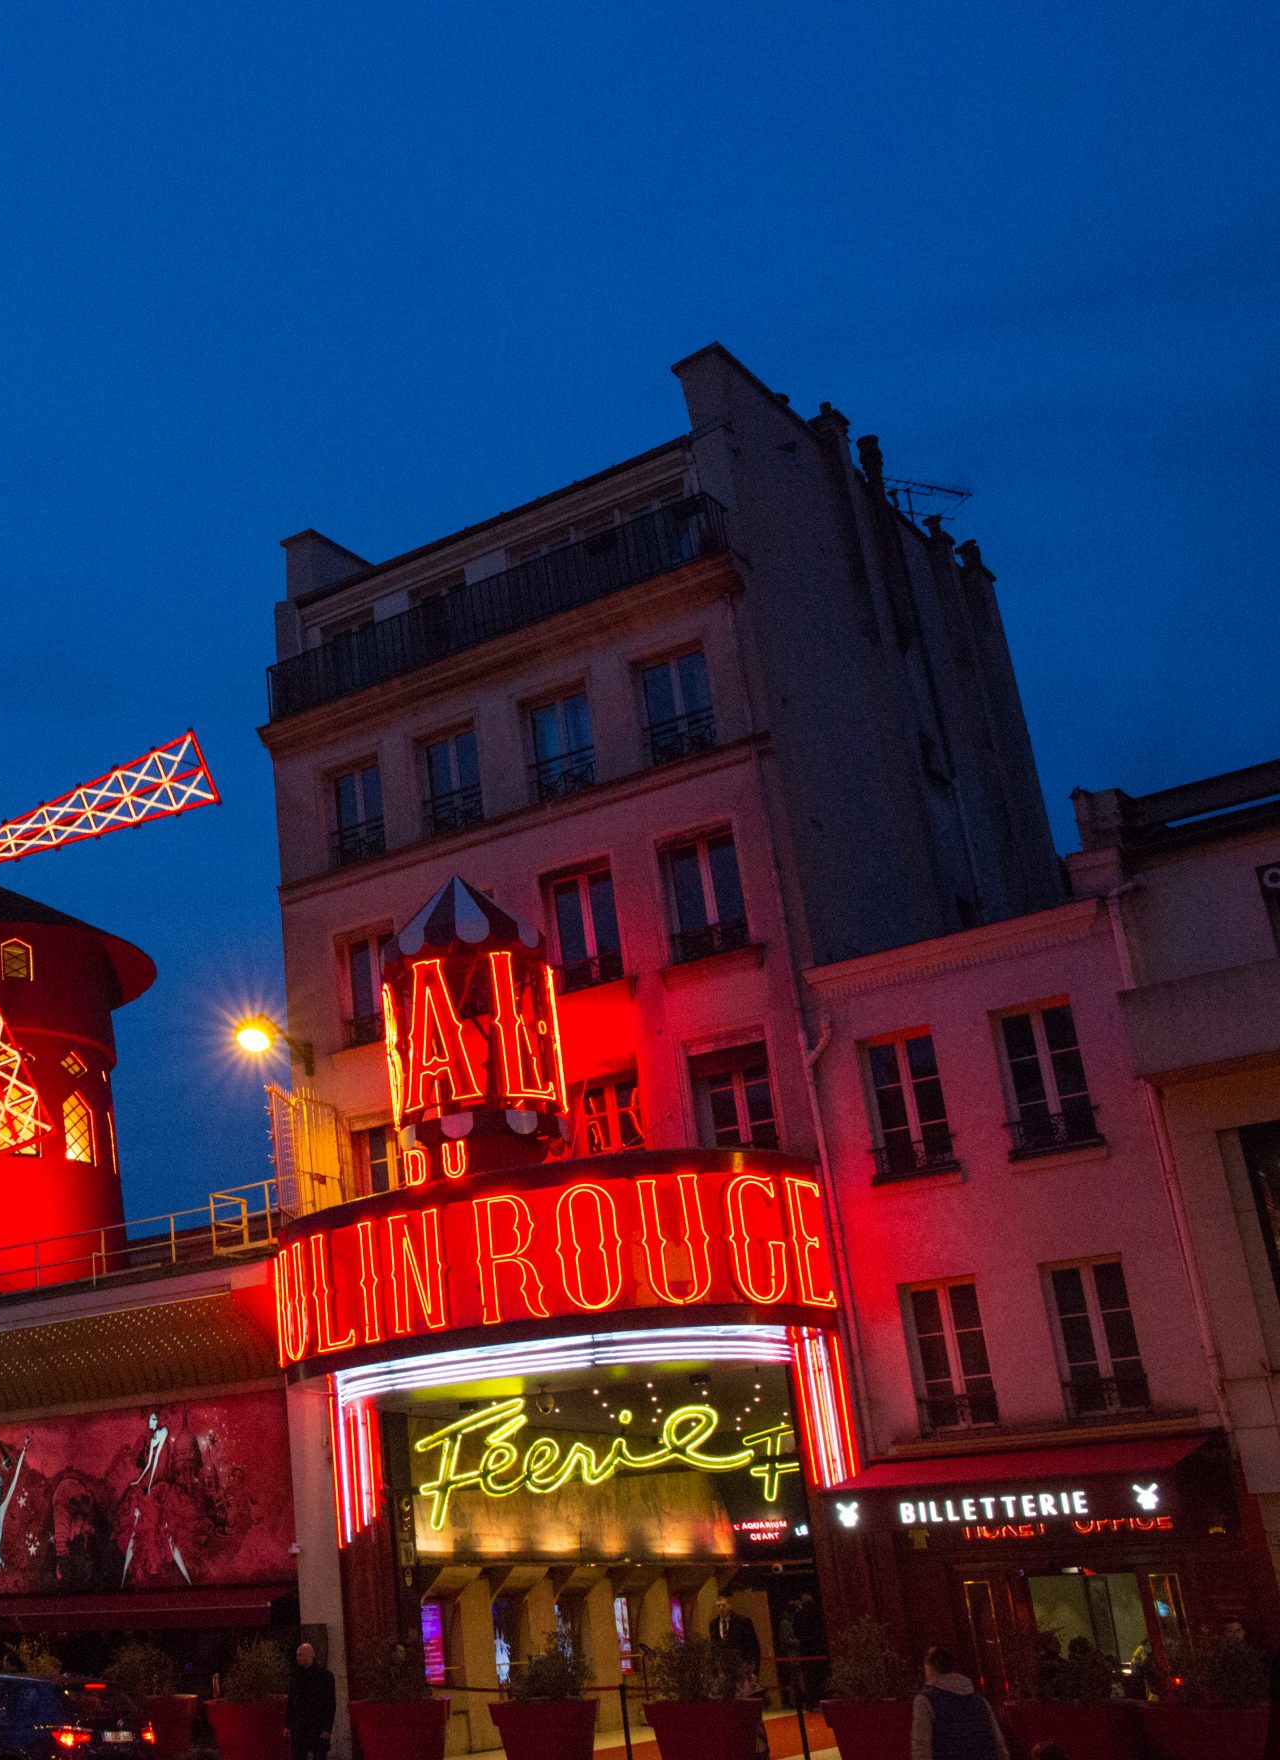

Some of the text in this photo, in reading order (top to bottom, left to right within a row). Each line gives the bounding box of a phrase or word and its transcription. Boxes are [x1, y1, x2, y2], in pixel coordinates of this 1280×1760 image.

[404, 1140, 466, 1187] DU
[273, 1174, 838, 1368] ULIN ROUGE
[415, 1397, 755, 1532] Féerie
[899, 1491, 1089, 1524] BILLETTERIE
